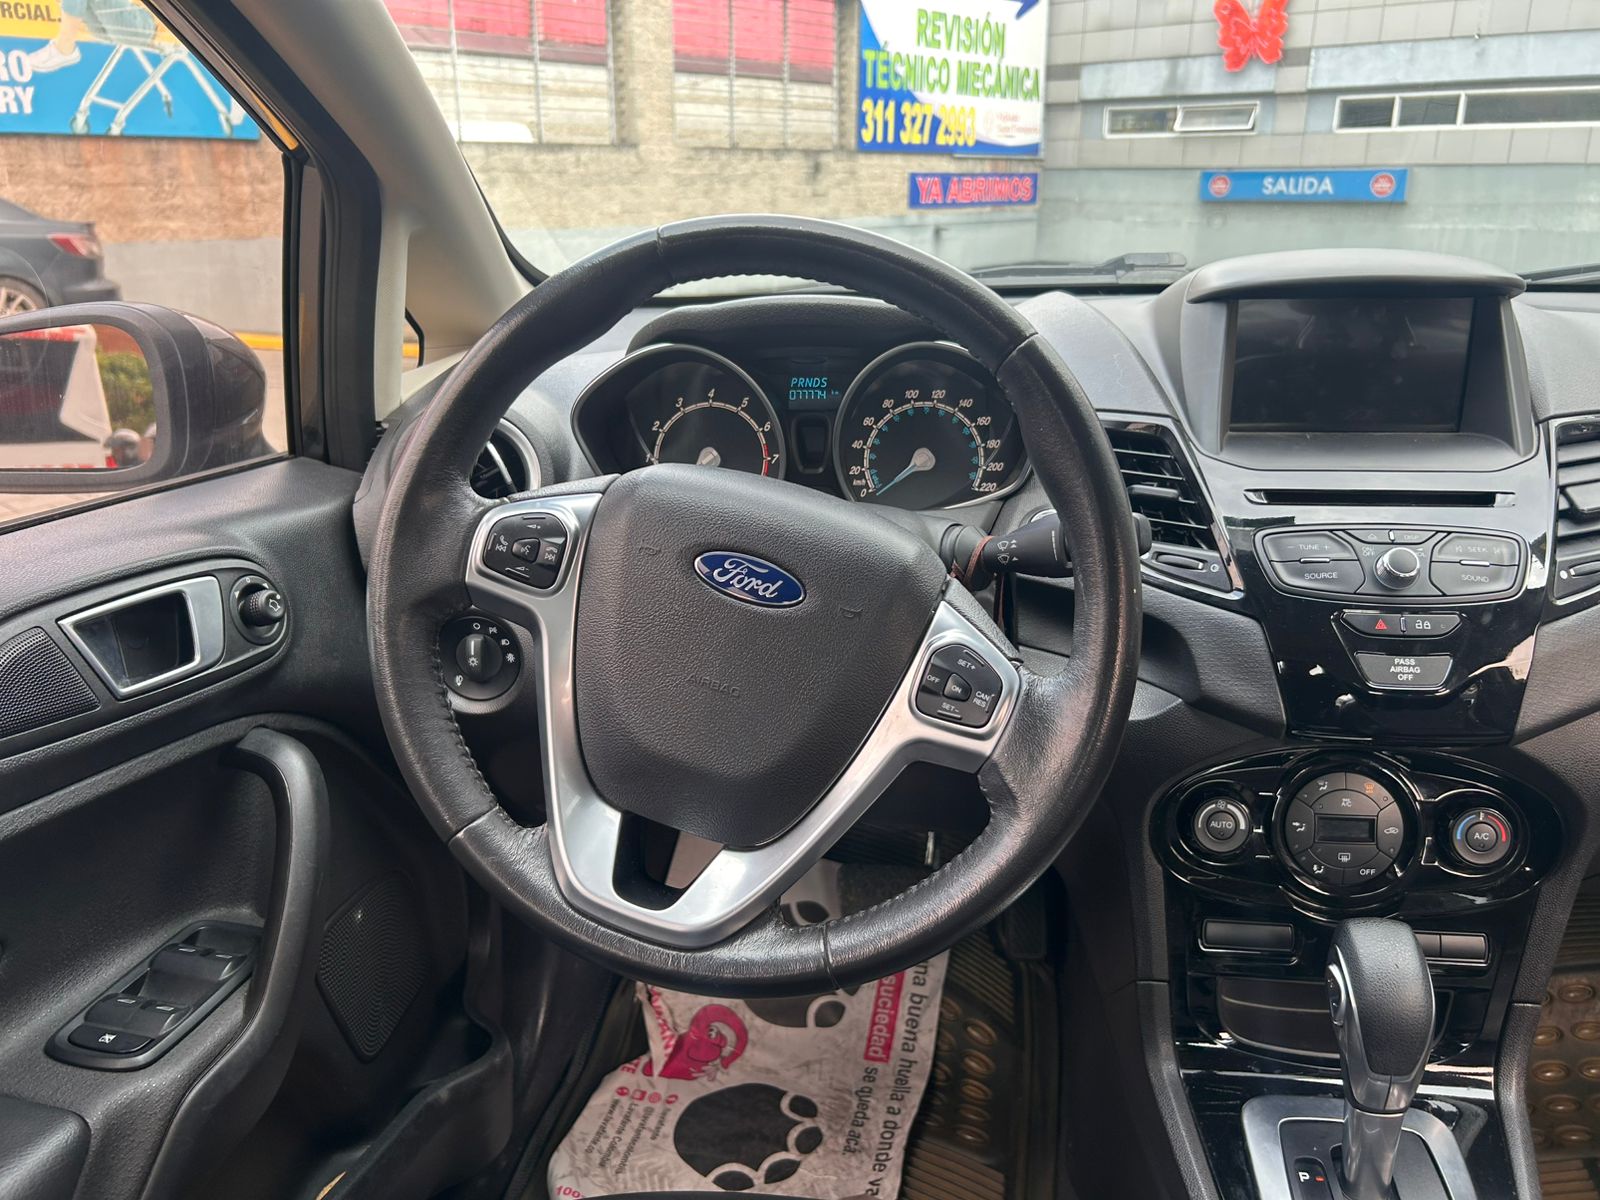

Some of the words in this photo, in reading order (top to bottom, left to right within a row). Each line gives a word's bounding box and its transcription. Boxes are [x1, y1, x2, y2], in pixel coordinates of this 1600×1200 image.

[917, 8, 1006, 57] REVISIÓN
[956, 60, 1040, 100] MECÁNICA
[861, 98, 895, 143] 311
[900, 101, 934, 145] 327
[916, 176, 943, 204] YA
[947, 176, 1033, 203] ABRIMOS
[1261, 176, 1334, 195] SALIDA
[791, 377, 828, 388] PRNDS
[905, 390, 919, 399] 100
[931, 390, 946, 399] 120
[882, 399, 894, 409] 80
[959, 399, 973, 408] 140
[863, 417, 875, 426] 60
[976, 416, 991, 425] 160
[852, 440, 864, 449] 40
[986, 439, 1000, 449] 180
[849, 465, 861, 475] 20
[987, 463, 1004, 472] 200
[980, 483, 997, 492] 220
[1299, 543, 1320, 551] TUNE
[713, 558, 783, 599] Ford
[1304, 572, 1339, 580] SOURCE
[1462, 574, 1489, 583] SOUND
[1394, 658, 1416, 666] PASS
[1390, 665, 1421, 674] AIRBAG
[927, 675, 940, 683] OFF
[1397, 673, 1414, 681] OFF
[951, 685, 962, 693] ON
[976, 691, 990, 701] CAN
[973, 698, 986, 708] RES
[1210, 820, 1233, 829] AUTO
[1474, 832, 1489, 840] A/C
[1360, 868, 1376, 876] OFF
[912, 960, 929, 987] na
[868, 975, 897, 1061] suciedad
[902, 993, 929, 1053] buena
[863, 1066, 878, 1083] se
[890, 1059, 918, 1102] huella
[851, 1086, 873, 1128] queda
[886, 1106, 902, 1116] a
[872, 1120, 901, 1173] donde
[1298, 1171, 1310, 1182] P
[865, 1177, 883, 1197] va
